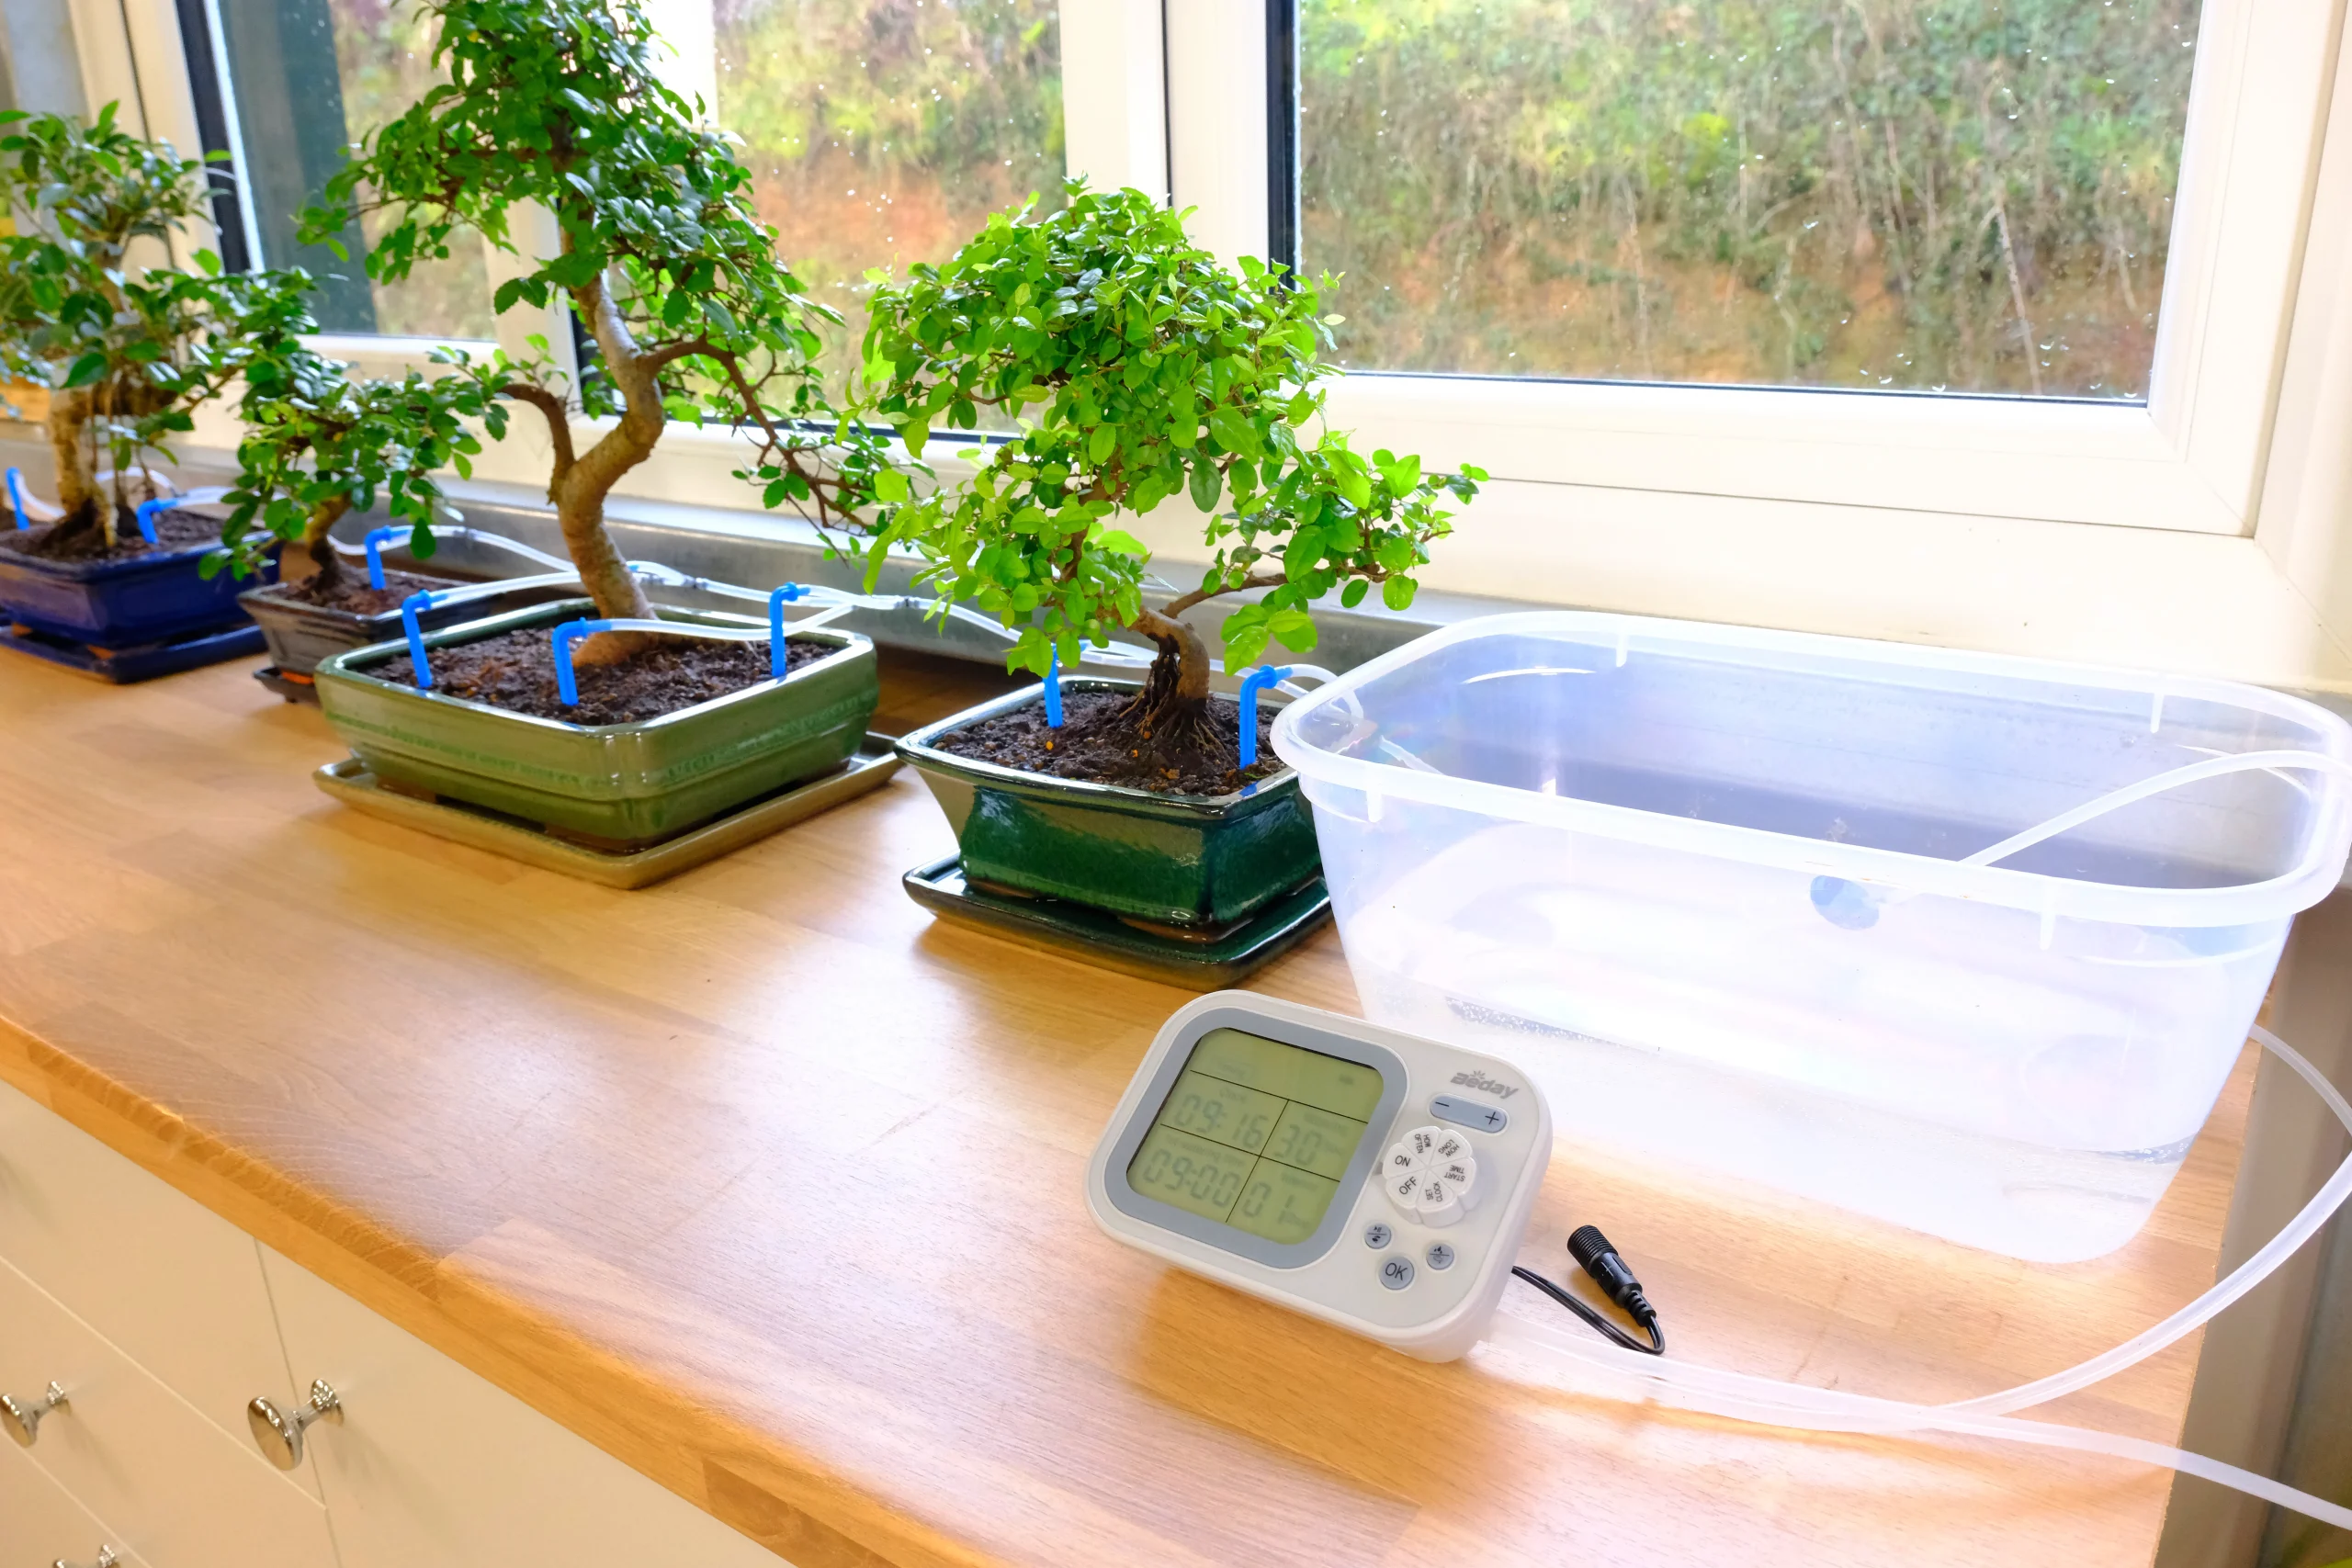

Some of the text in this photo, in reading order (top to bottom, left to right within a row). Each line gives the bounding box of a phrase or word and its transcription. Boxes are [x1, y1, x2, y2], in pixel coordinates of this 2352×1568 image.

[1415, 1134, 1424, 1154] OFTEN
[1423, 1134, 1431, 1148] HOW
[1438, 1139, 1454, 1154] LONG
[1445, 1144, 1460, 1157] HOW
[1395, 1155, 1411, 1167] ON
[1444, 1171, 1466, 1182] START
[1450, 1165, 1464, 1174] TIME
[1398, 1177, 1417, 1195] OFF
[1432, 1180, 1443, 1202] CLOCK
[1425, 1189, 1433, 1201] SET
[1385, 1262, 1408, 1281] OK
